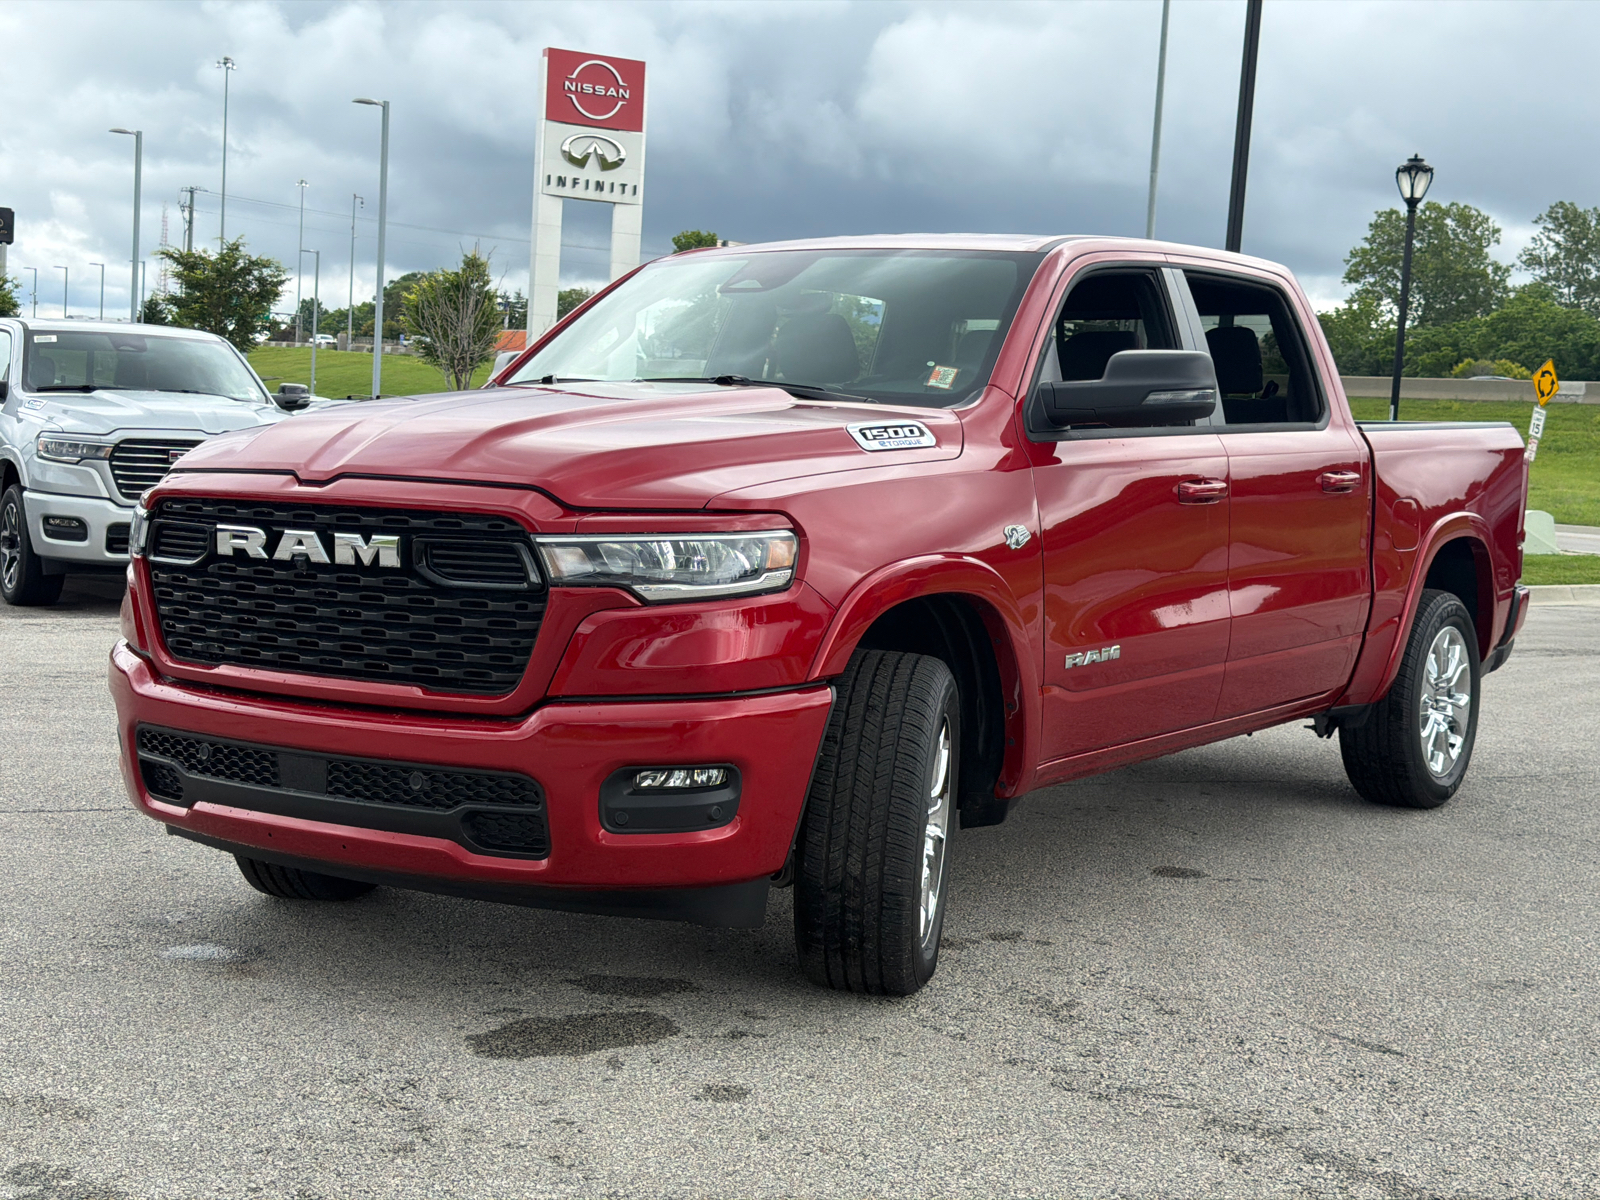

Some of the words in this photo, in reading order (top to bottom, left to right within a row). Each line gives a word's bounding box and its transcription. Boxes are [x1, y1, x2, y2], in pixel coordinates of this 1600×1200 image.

[564, 81, 630, 99] NISSAN
[546, 174, 637, 196] INFINITI
[861, 426, 921, 440] 1500
[1532, 422, 1540, 434] 15
[216, 524, 400, 567] RAM
[1065, 645, 1120, 669] RAM
